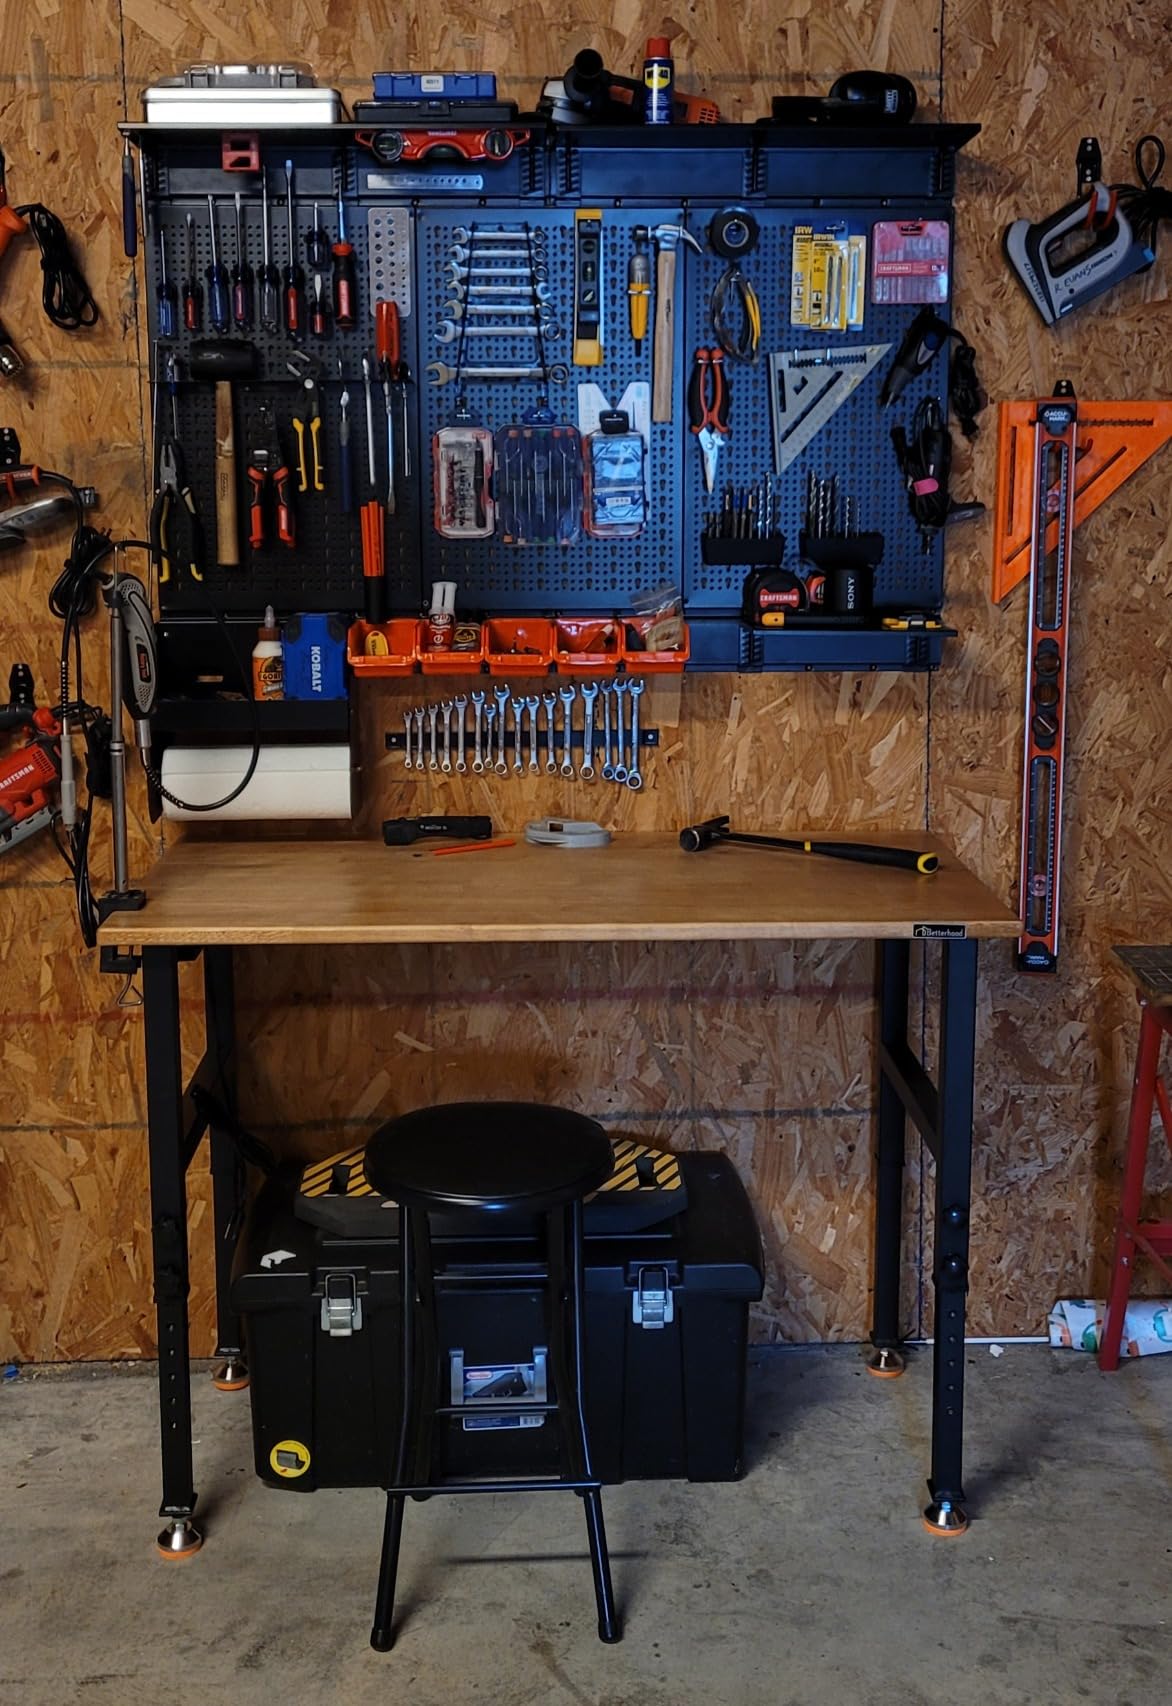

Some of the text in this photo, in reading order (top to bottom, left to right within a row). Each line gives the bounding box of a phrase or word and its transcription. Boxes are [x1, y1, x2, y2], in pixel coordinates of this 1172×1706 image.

[847, 577, 855, 609] SONY
[311, 645, 322, 692] KOBALT
[0, 764, 35, 790] RAFTSMAN
